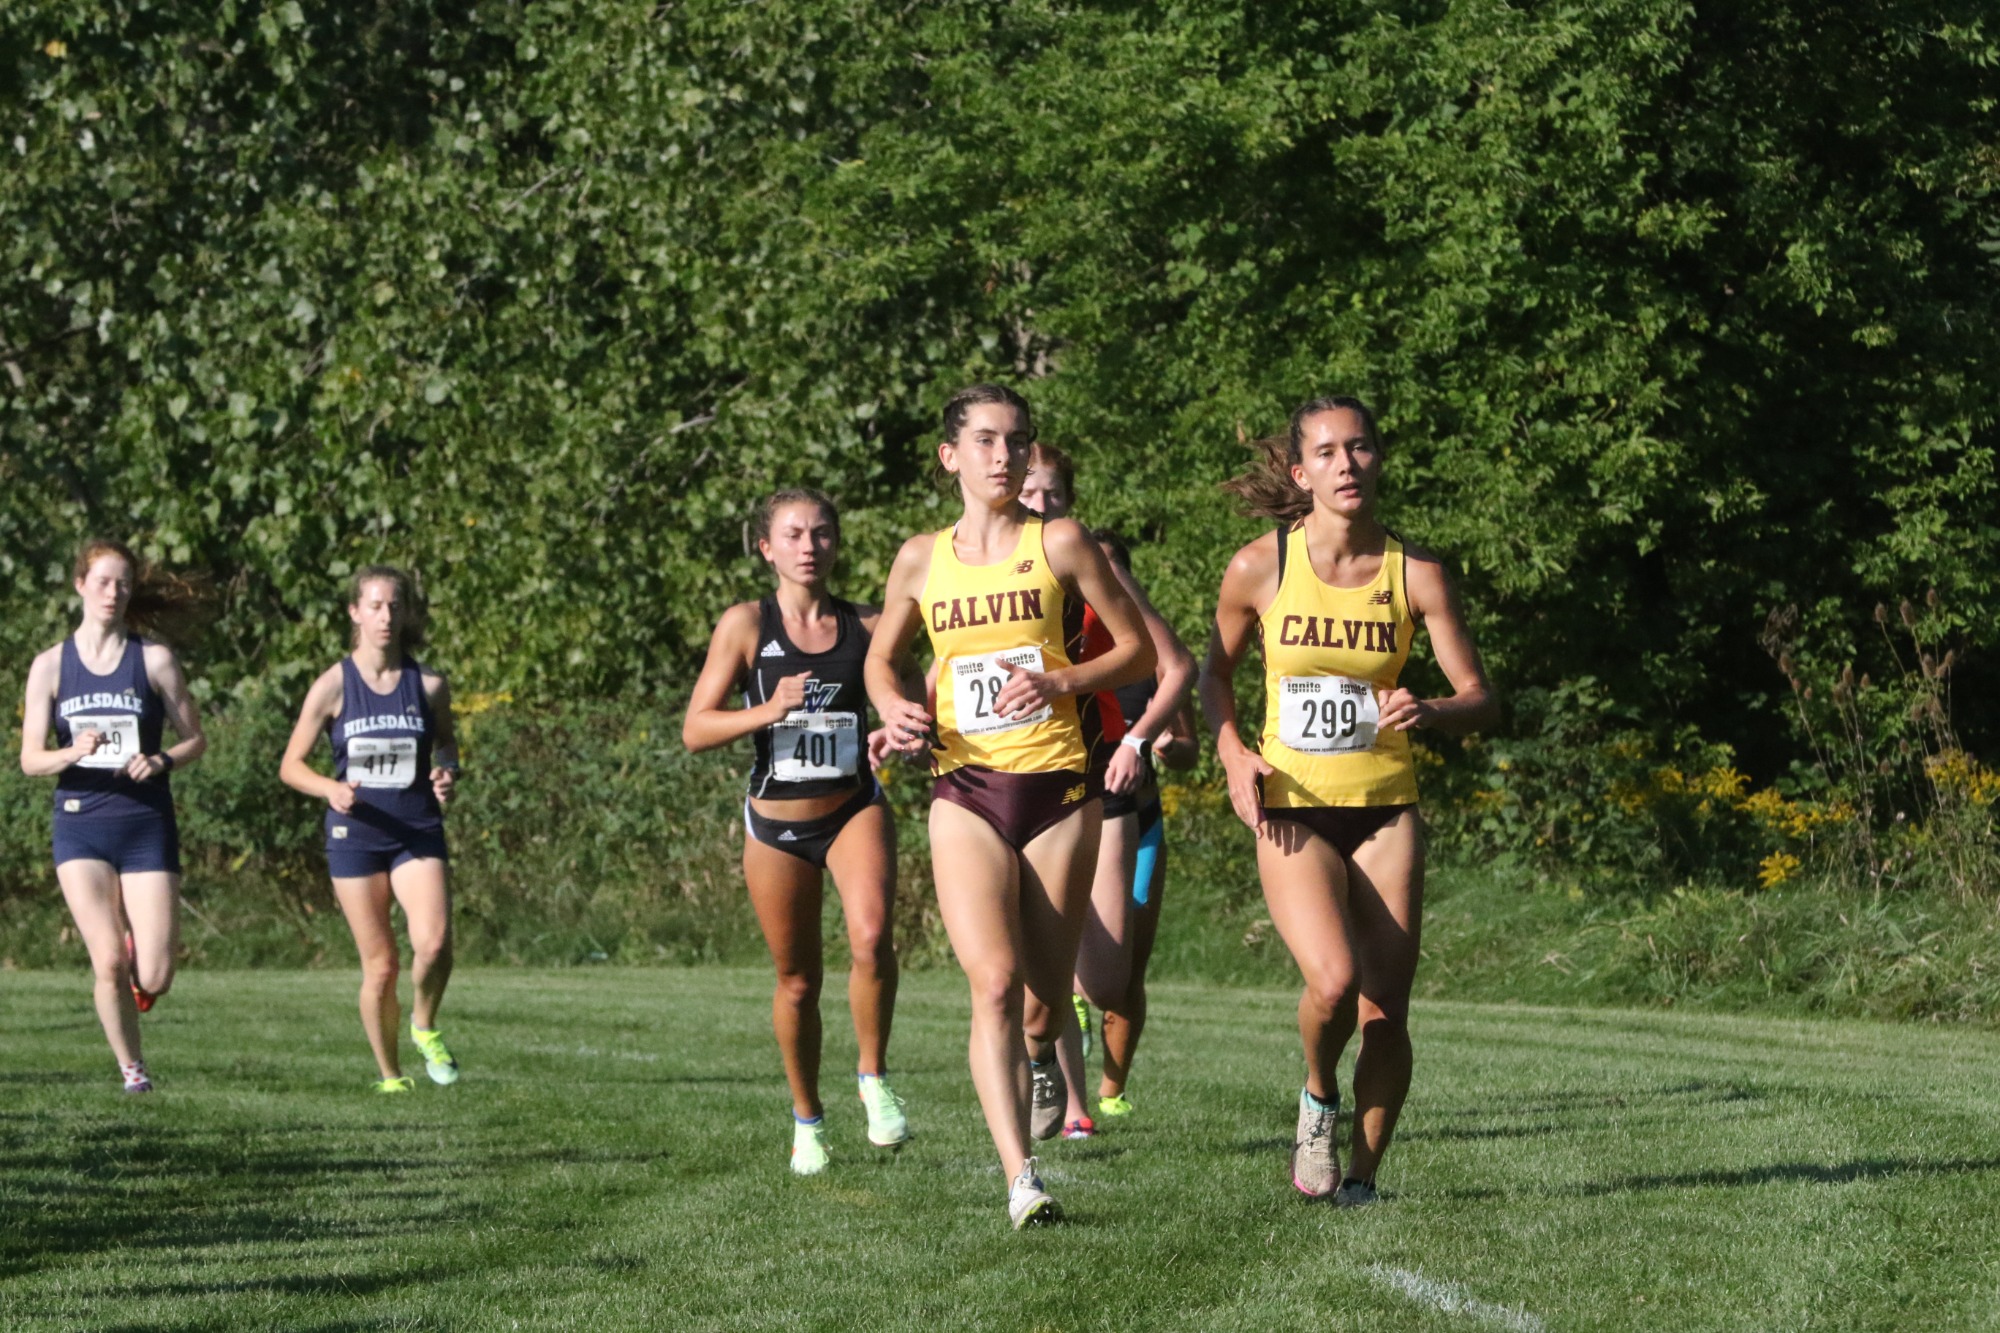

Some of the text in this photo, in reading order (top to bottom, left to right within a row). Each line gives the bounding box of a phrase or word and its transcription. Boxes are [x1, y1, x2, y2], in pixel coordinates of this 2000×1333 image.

[932, 588, 1044, 633] CALVIN
[1280, 615, 1397, 653] CALVIN
[957, 662, 984, 676] ignite
[970, 673, 1027, 718] 28
[1288, 680, 1368, 695] ignite ignite
[60, 692, 142, 717] HILLSDALE
[344, 715, 425, 738] HILLSDALE
[780, 716, 853, 729] ignite ignite
[1302, 699, 1357, 738] 299
[793, 733, 836, 767] 401
[363, 754, 398, 775] 417
